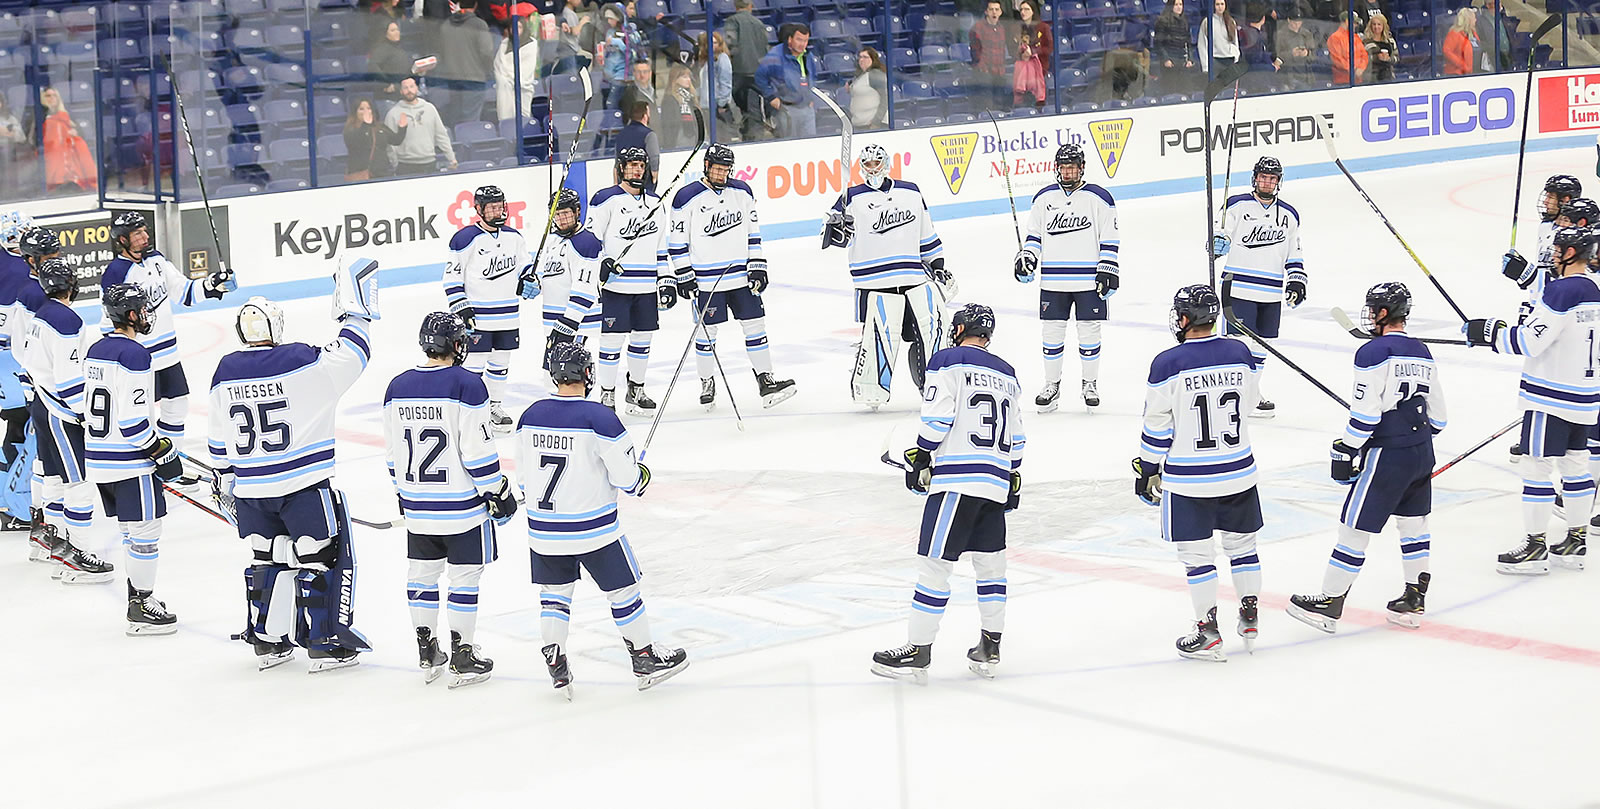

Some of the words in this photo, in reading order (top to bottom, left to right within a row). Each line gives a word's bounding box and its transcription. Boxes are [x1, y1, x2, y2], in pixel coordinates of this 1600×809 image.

[1097, 122, 1124, 132] SURVIVE
[1361, 87, 1515, 143] GEICO
[940, 137, 968, 147] SURVIVE
[982, 130, 1048, 154] Buckle
[1102, 132, 1120, 141] YOUR
[1160, 113, 1334, 157] POWERADE
[946, 147, 965, 156] YOUR
[767, 152, 911, 199] DUNK'
[989, 160, 1010, 178] No
[274, 206, 440, 260] KeyBank
[619, 216, 659, 240] Mane
[704, 210, 744, 237] Maine
[872, 207, 916, 235] Maine
[1047, 212, 1092, 235] Maine
[84, 225, 111, 244] RO
[1241, 225, 1286, 249] Maine
[85, 250, 96, 261] of
[483, 254, 518, 280] Main
[1208, 306, 1218, 314] 13
[981, 319, 992, 328] 30
[424, 335, 435, 344] 12
[559, 363, 566, 371] 7
[857, 348, 867, 376] CCM
[227, 382, 284, 401] THIESSEN
[1185, 372, 1243, 391] RENNAKER
[399, 406, 443, 421] POISSON
[1191, 390, 1242, 451] 13
[229, 398, 292, 456] 35
[533, 433, 574, 451] DROBOT
[403, 426, 449, 485] 12
[9, 448, 29, 493] CCM
[537, 452, 569, 513] 7
[338, 569, 353, 626] VAUGHN
